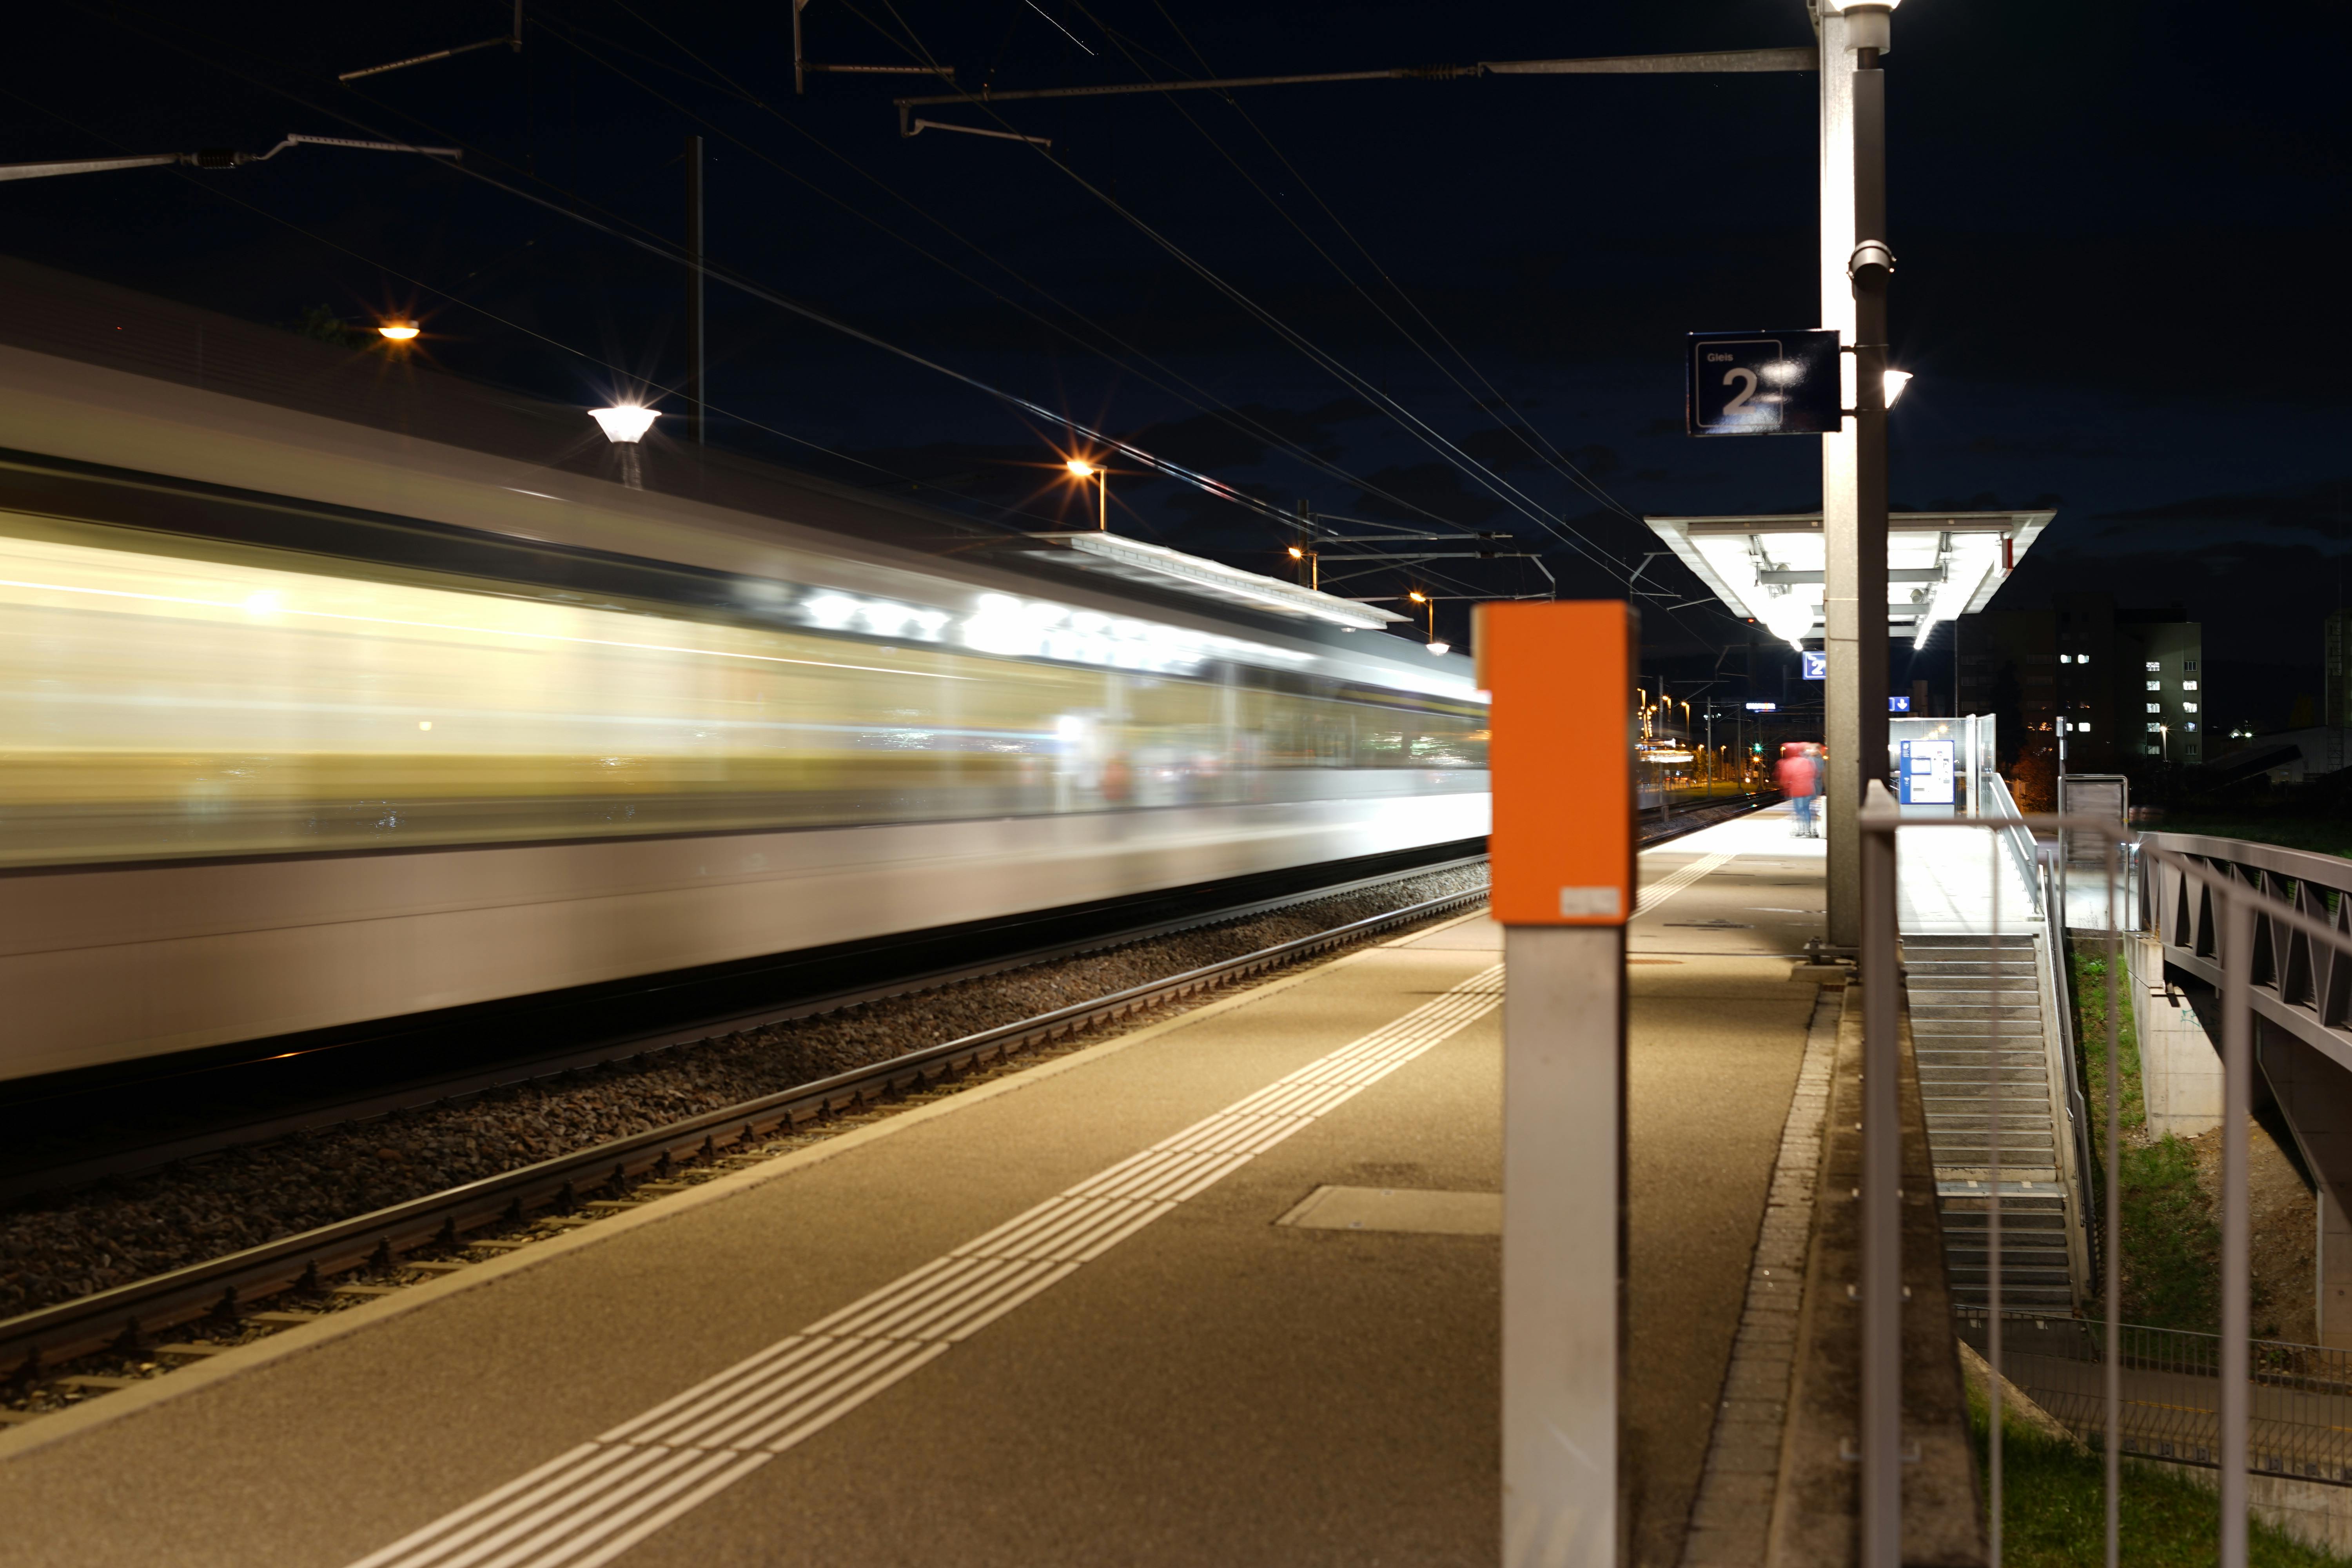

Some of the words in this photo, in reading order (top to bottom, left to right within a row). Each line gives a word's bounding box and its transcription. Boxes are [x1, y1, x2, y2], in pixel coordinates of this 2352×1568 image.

[1707, 353, 1733, 361] Gleis
[1723, 367, 1757, 415] 2
[1811, 660, 1824, 675] 2
